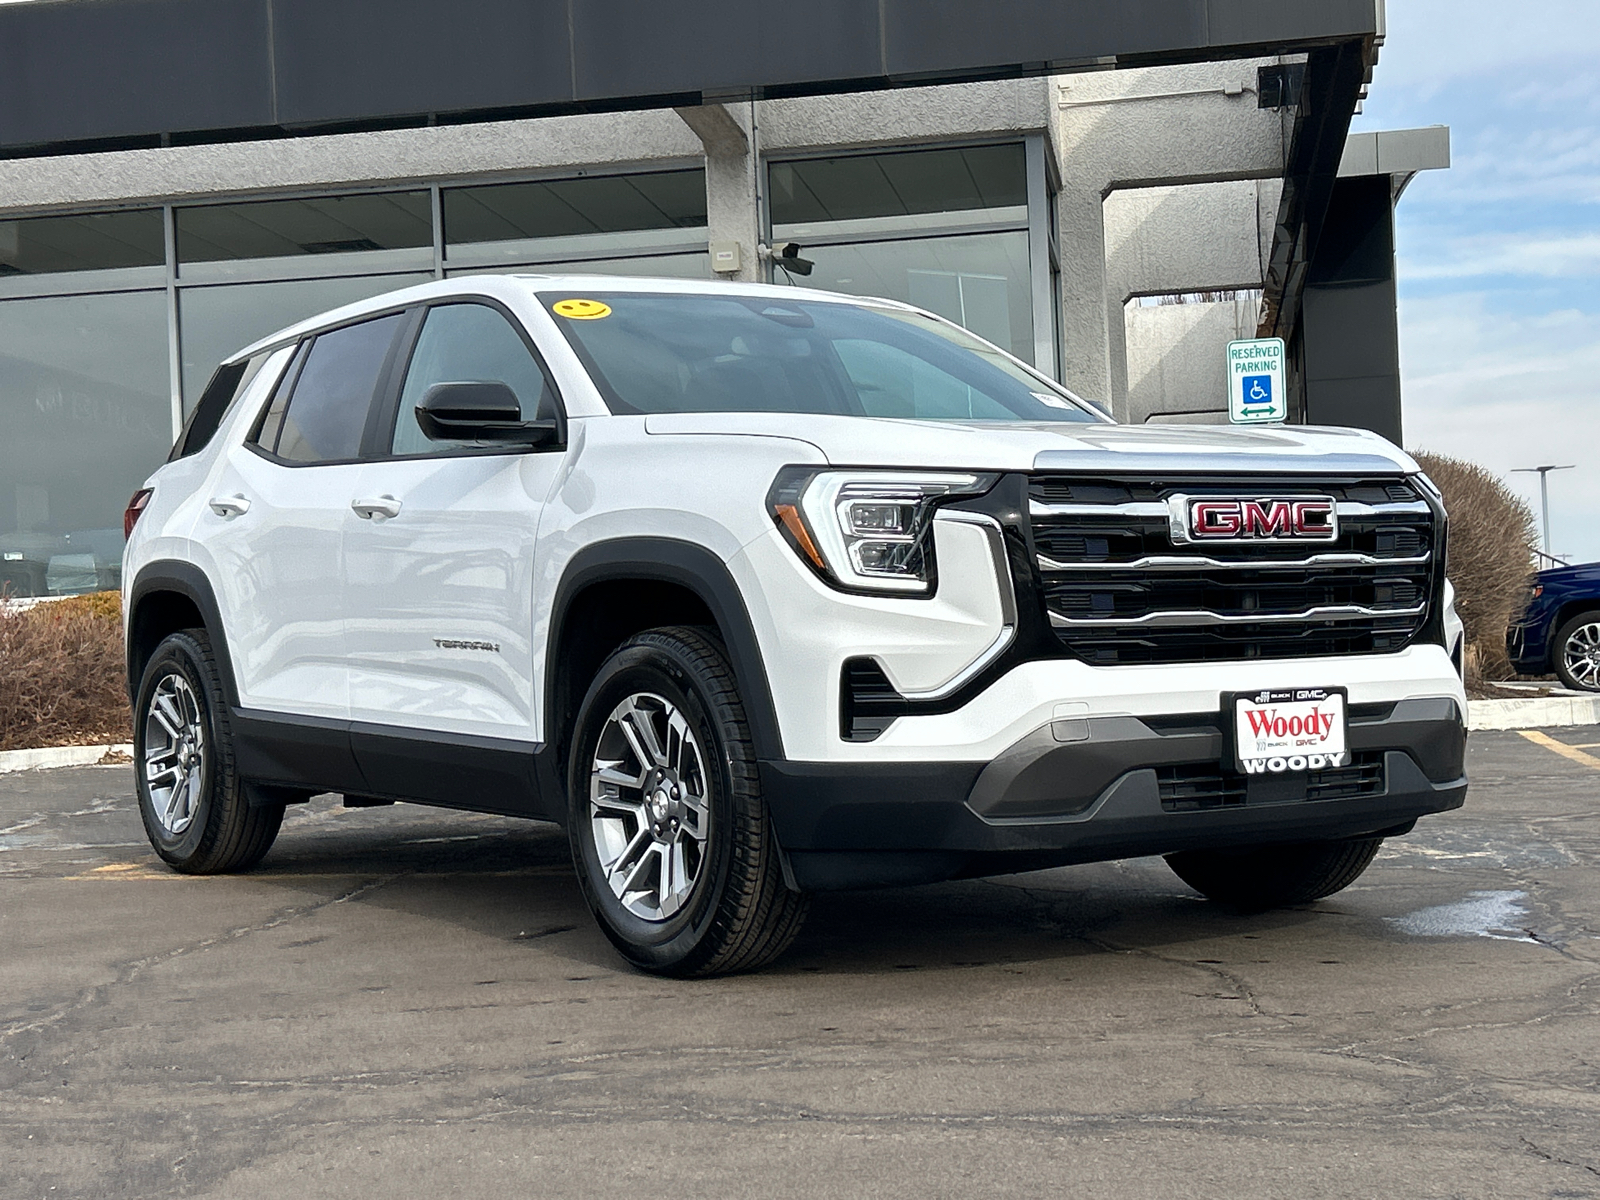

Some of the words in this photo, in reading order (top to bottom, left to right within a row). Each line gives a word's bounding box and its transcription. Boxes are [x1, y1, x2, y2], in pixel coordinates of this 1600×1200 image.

[1231, 346, 1280, 360] RESERVED
[1235, 360, 1277, 373] PARKING
[1191, 501, 1335, 537] GMC
[1296, 689, 1324, 700] GMC
[1244, 707, 1335, 741] Woody
[1295, 738, 1318, 747] GMC
[1242, 753, 1345, 773] WOODY
